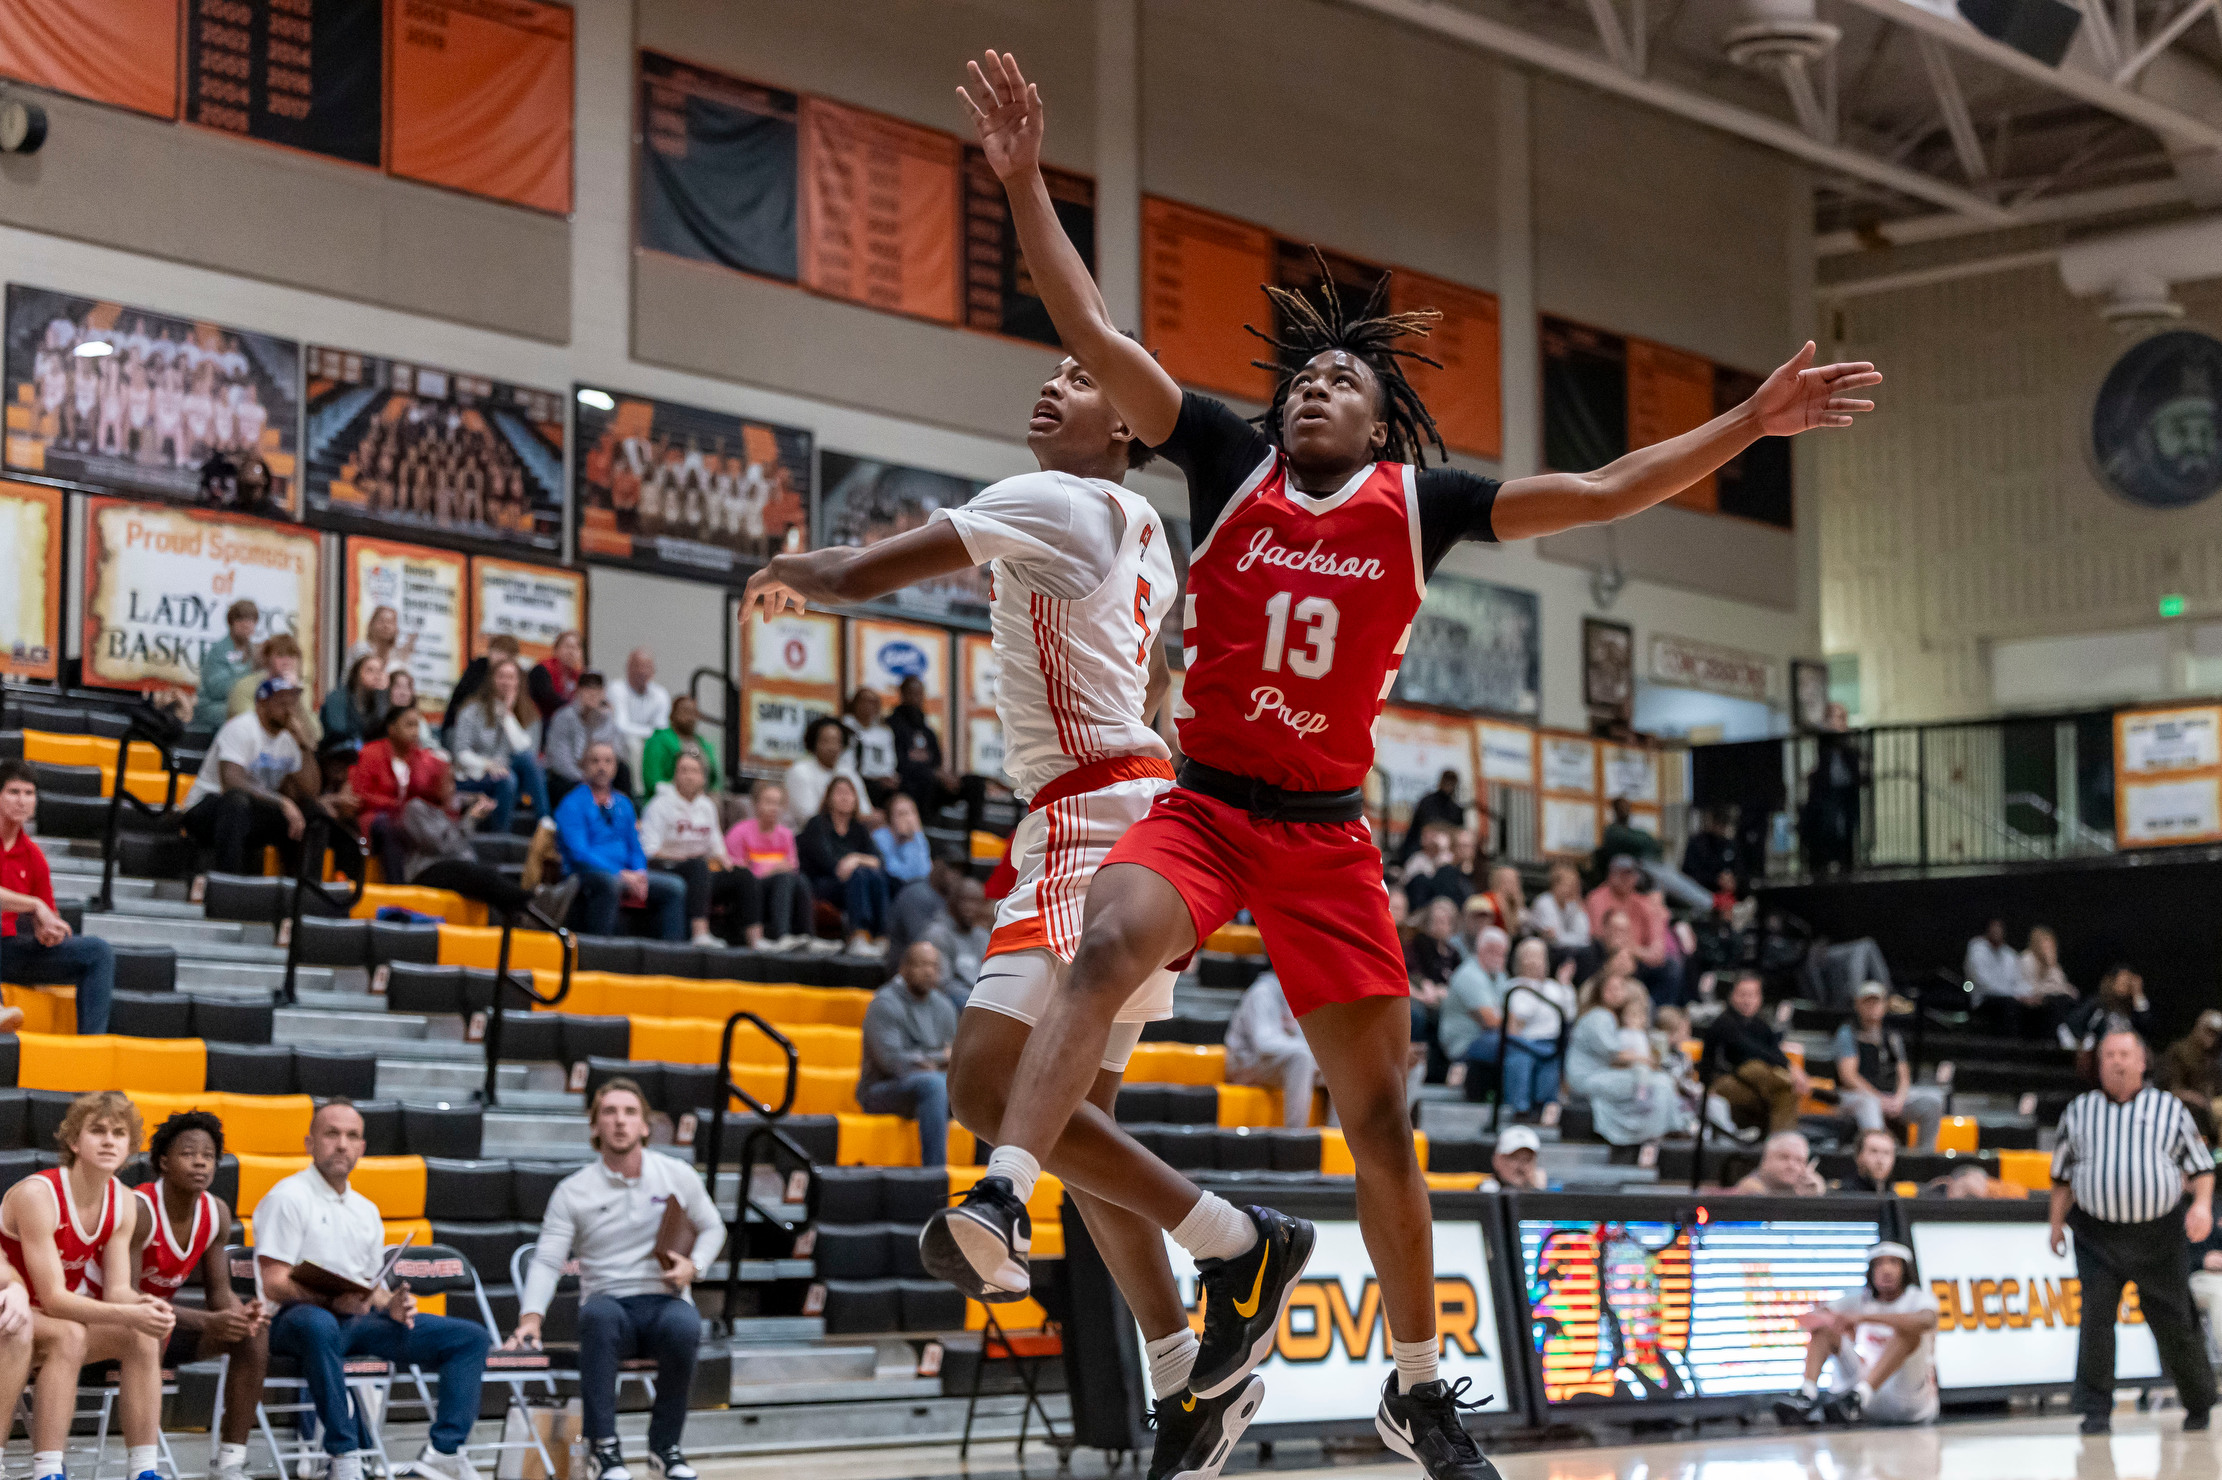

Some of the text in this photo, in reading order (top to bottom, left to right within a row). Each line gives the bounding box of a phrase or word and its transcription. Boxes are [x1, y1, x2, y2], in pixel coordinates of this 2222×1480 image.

[126, 520, 305, 575] Proud Sponsors
[1236, 527, 1385, 581] Jackson
[212, 569, 235, 594] of
[128, 589, 217, 630] LADY
[1134, 573, 1151, 667] 5
[1262, 591, 1341, 680] 13
[1244, 686, 1330, 739] Prep
